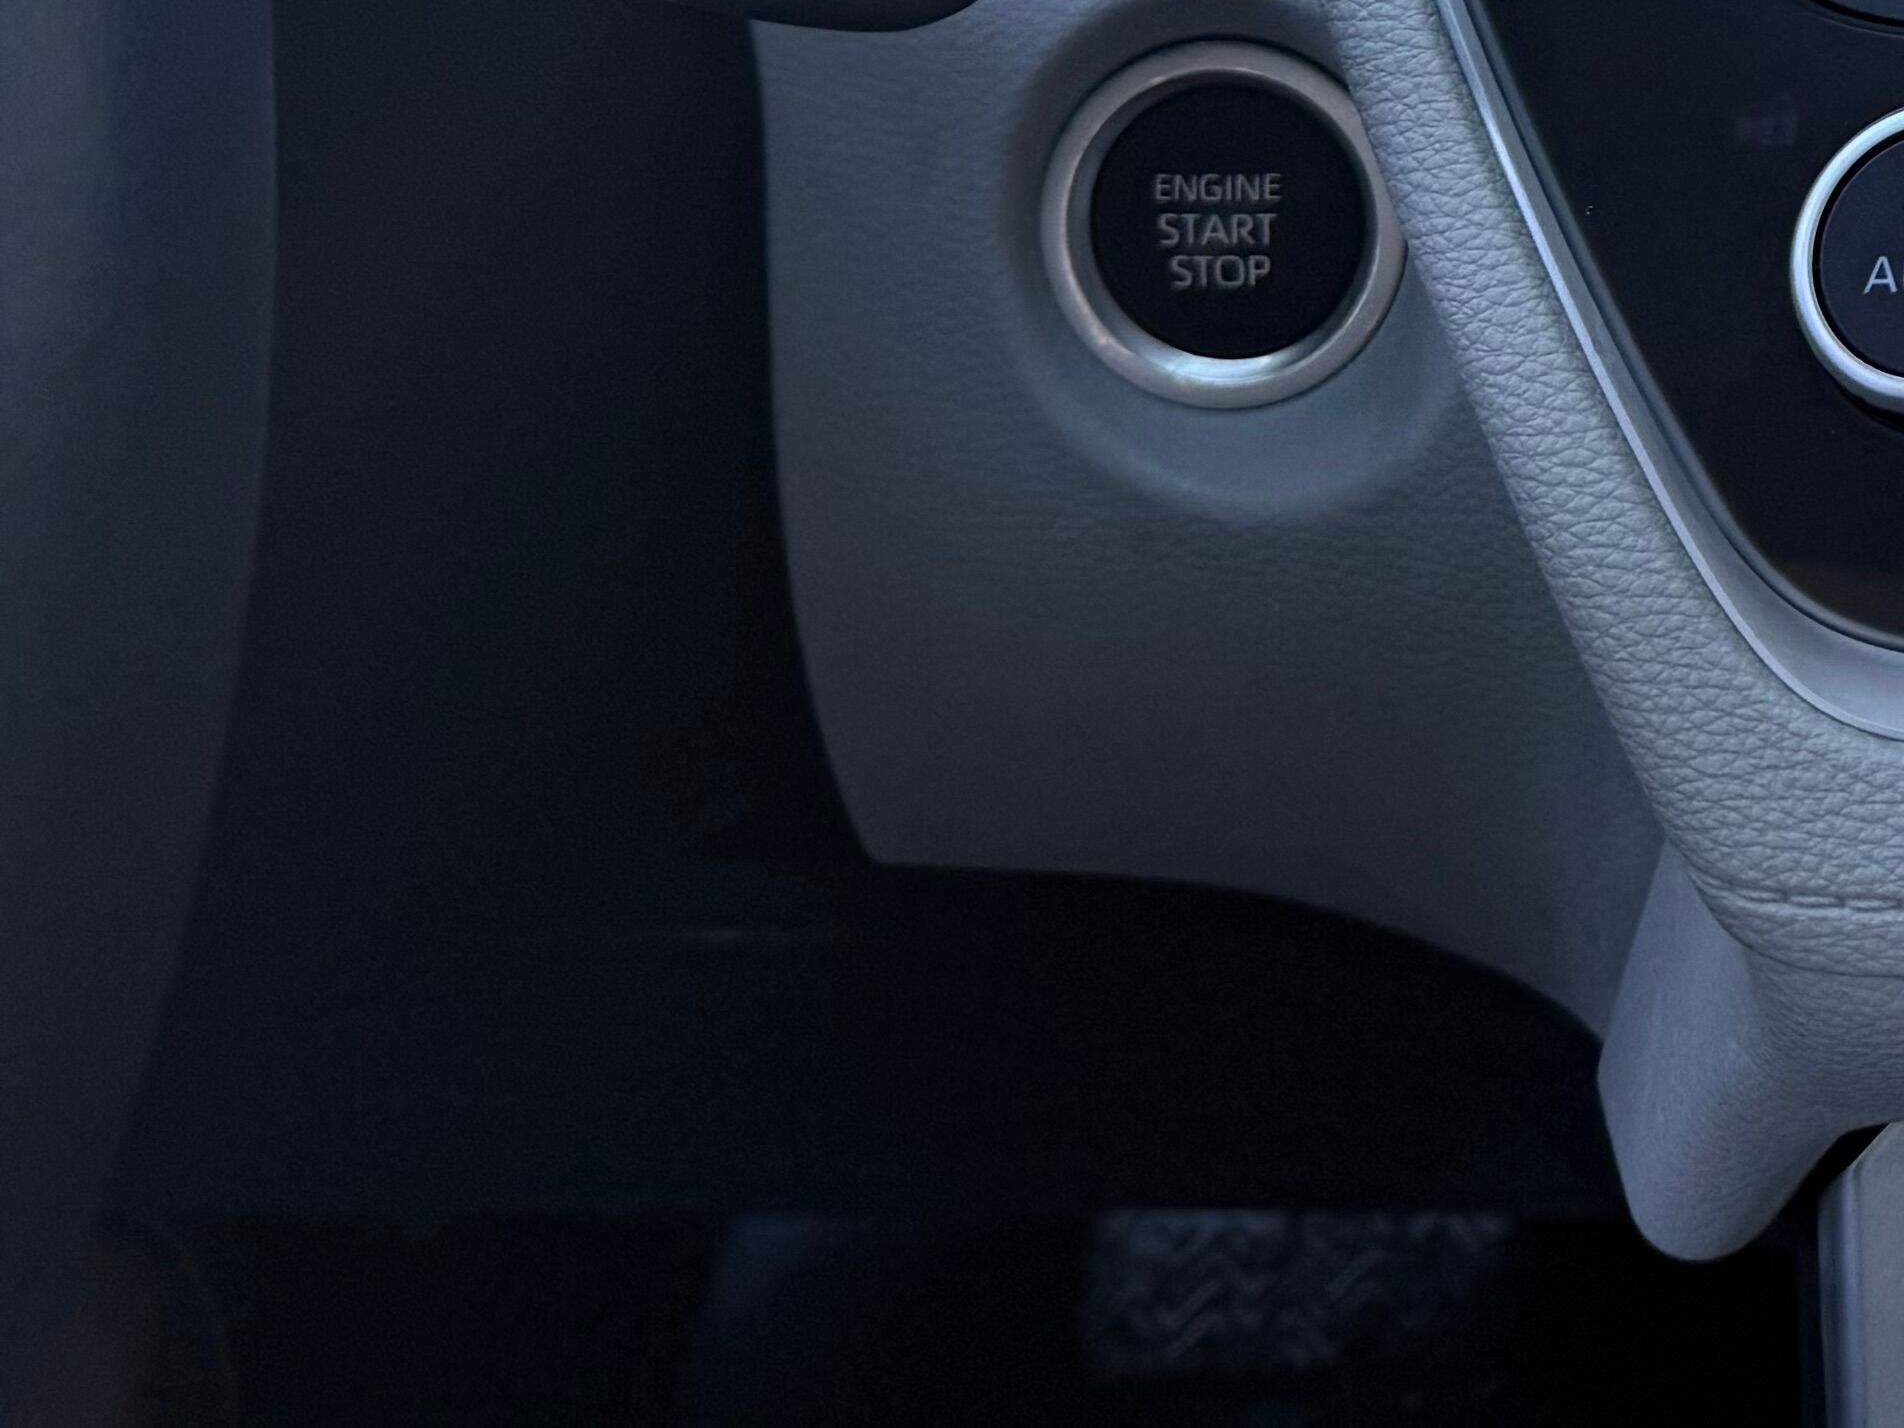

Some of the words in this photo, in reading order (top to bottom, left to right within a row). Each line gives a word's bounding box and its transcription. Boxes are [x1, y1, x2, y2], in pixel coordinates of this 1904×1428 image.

[1153, 172, 1282, 205] ENGINE
[1156, 211, 1274, 249] START
[1169, 252, 1272, 291] STOP
